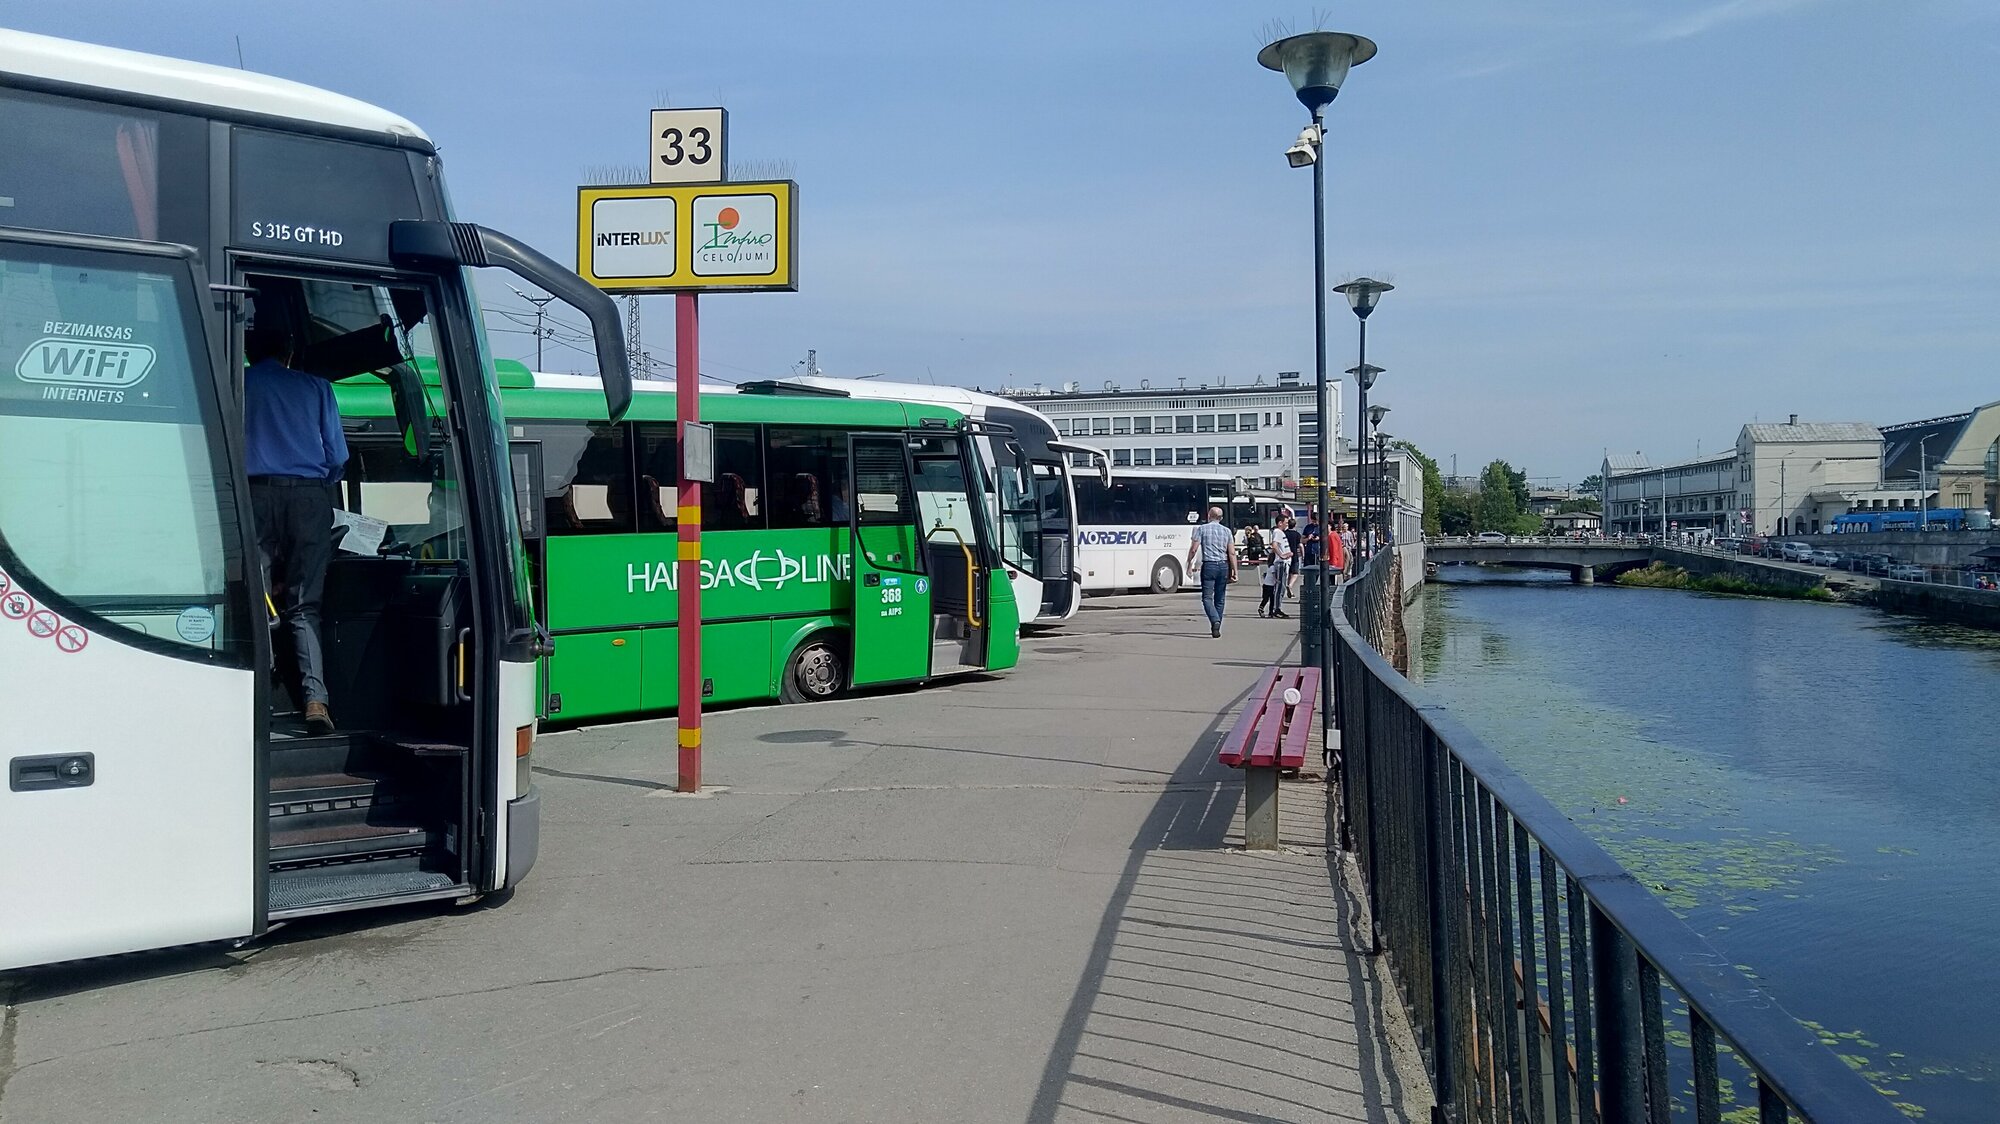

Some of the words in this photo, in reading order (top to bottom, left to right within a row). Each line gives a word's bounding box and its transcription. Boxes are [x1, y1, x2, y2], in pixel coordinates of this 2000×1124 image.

[659, 127, 712, 166] 33
[252, 221, 262, 237] S
[265, 222, 291, 240] 315
[294, 226, 316, 243] GT
[319, 229, 343, 246] HD
[43, 320, 133, 340] BEZMAKSAS
[42, 346, 130, 379] WiFi
[42, 386, 125, 404] INTERNETS
[1078, 530, 1148, 545] NORDEKA
[628, 558, 736, 593] HASA
[881, 587, 902, 604] 368
